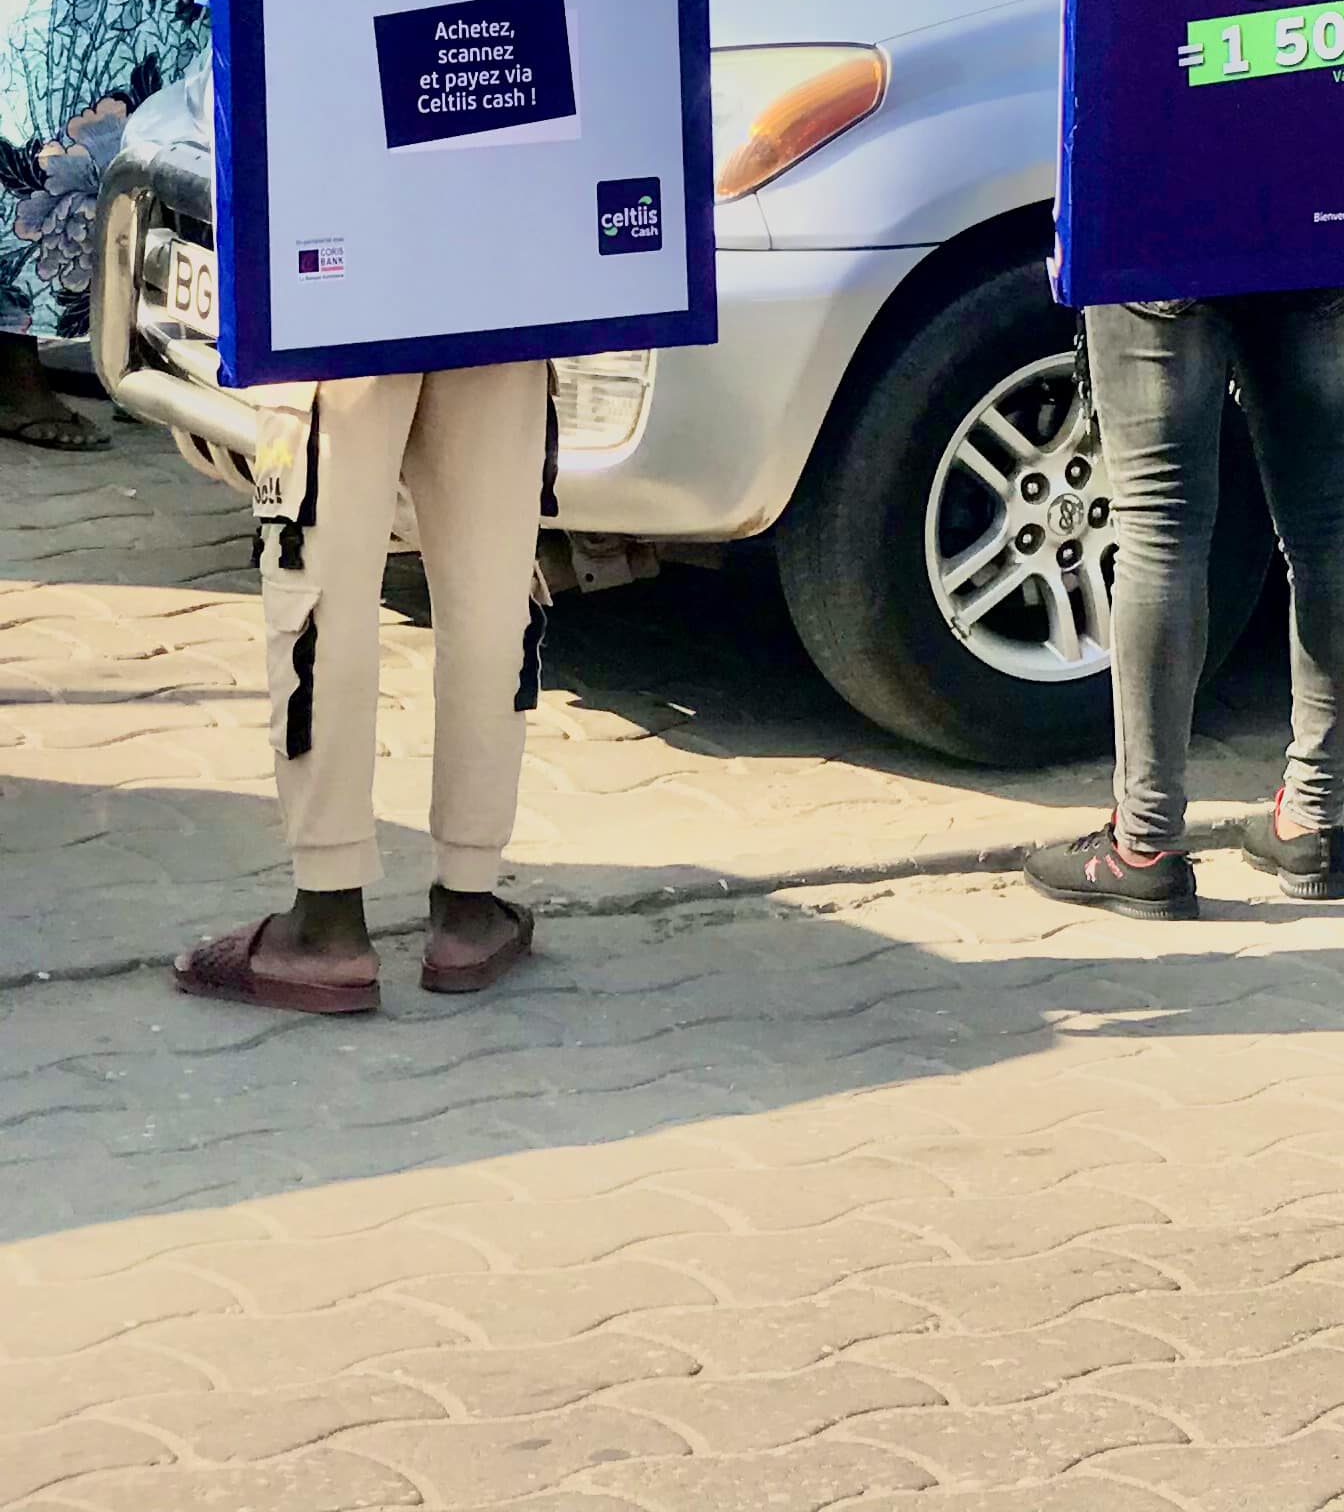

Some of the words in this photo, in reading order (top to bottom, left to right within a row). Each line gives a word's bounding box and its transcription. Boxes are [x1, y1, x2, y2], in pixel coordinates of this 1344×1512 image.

[434, 18, 516, 41] Achetez,
[437, 42, 514, 65] scannez
[1221, 24, 1250, 76] 1
[420, 70, 442, 90] et
[445, 67, 500, 95] payez
[505, 64, 533, 85] via
[417, 91, 478, 114] Celtiis
[482, 88, 526, 110] cash
[601, 204, 658, 230] celtiis
[631, 225, 659, 238] Cash
